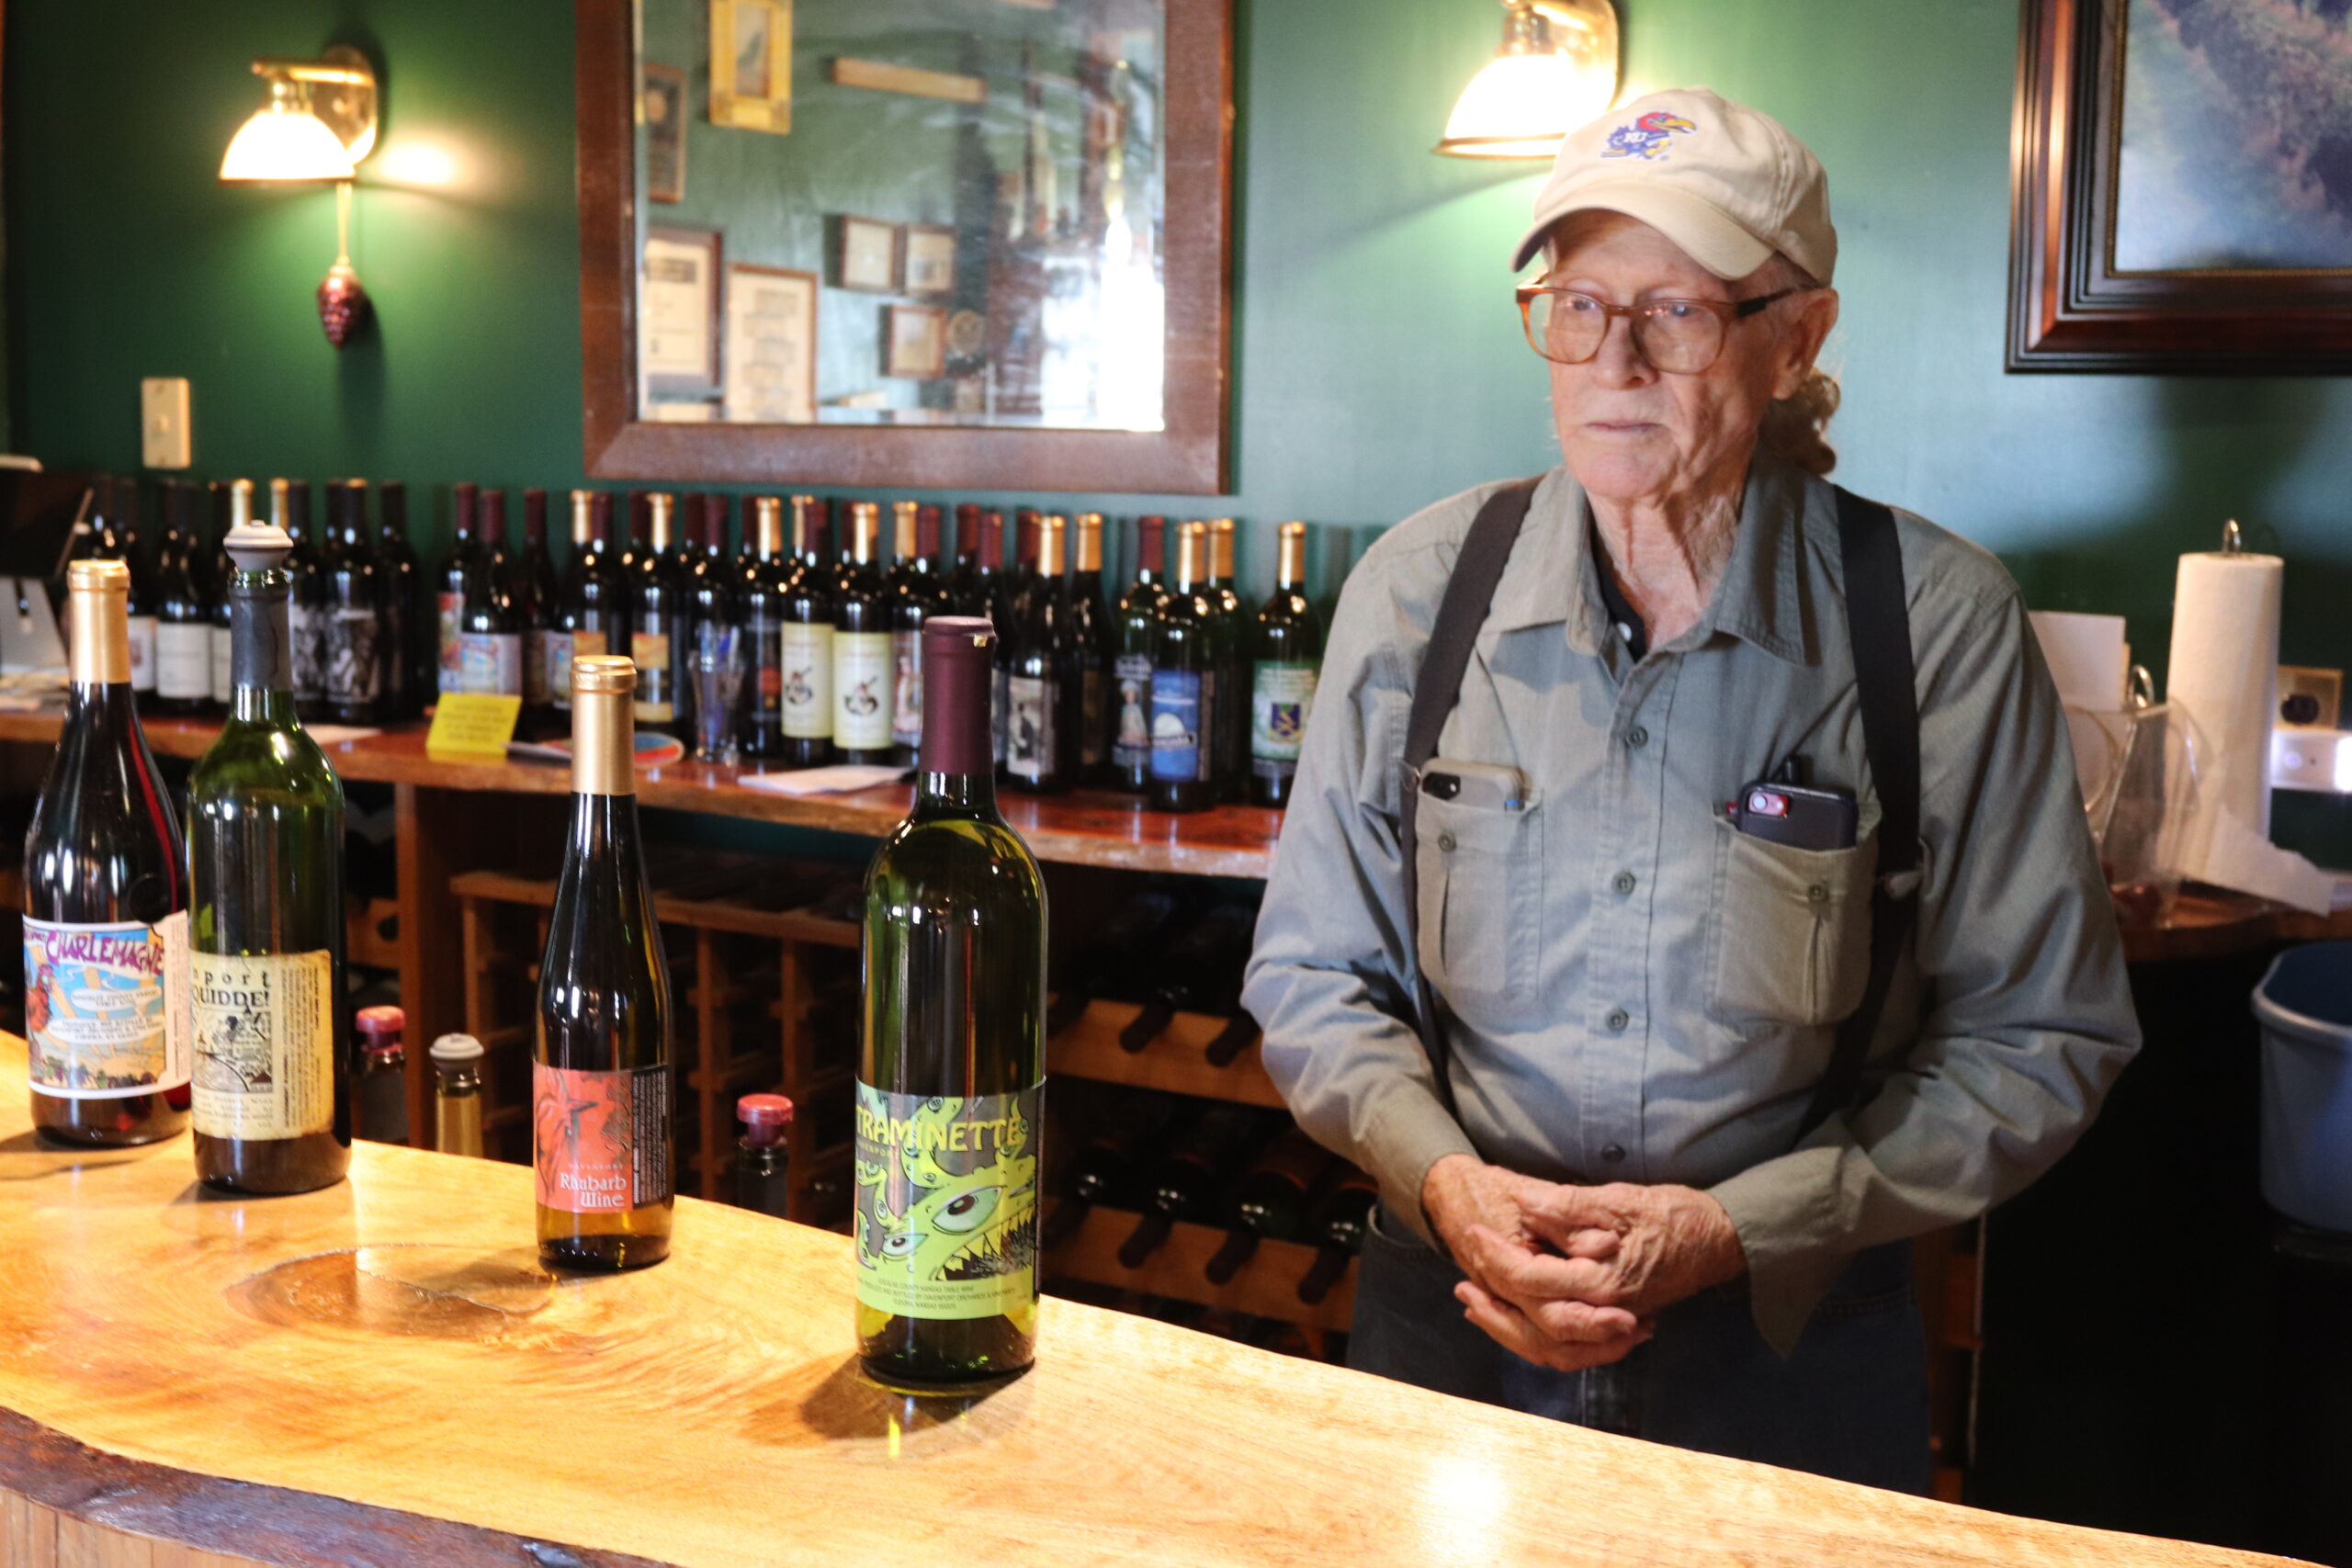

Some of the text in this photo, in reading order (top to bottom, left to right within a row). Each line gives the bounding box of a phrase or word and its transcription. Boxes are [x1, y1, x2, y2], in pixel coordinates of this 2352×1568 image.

[1623, 131, 1647, 143] KU
[46, 930, 165, 976] CHARLEMAGNE
[855, 1104, 1023, 1152] TRAMINETTE
[560, 1172, 628, 1191] Rhubarb
[580, 1191, 626, 1208] Wine
